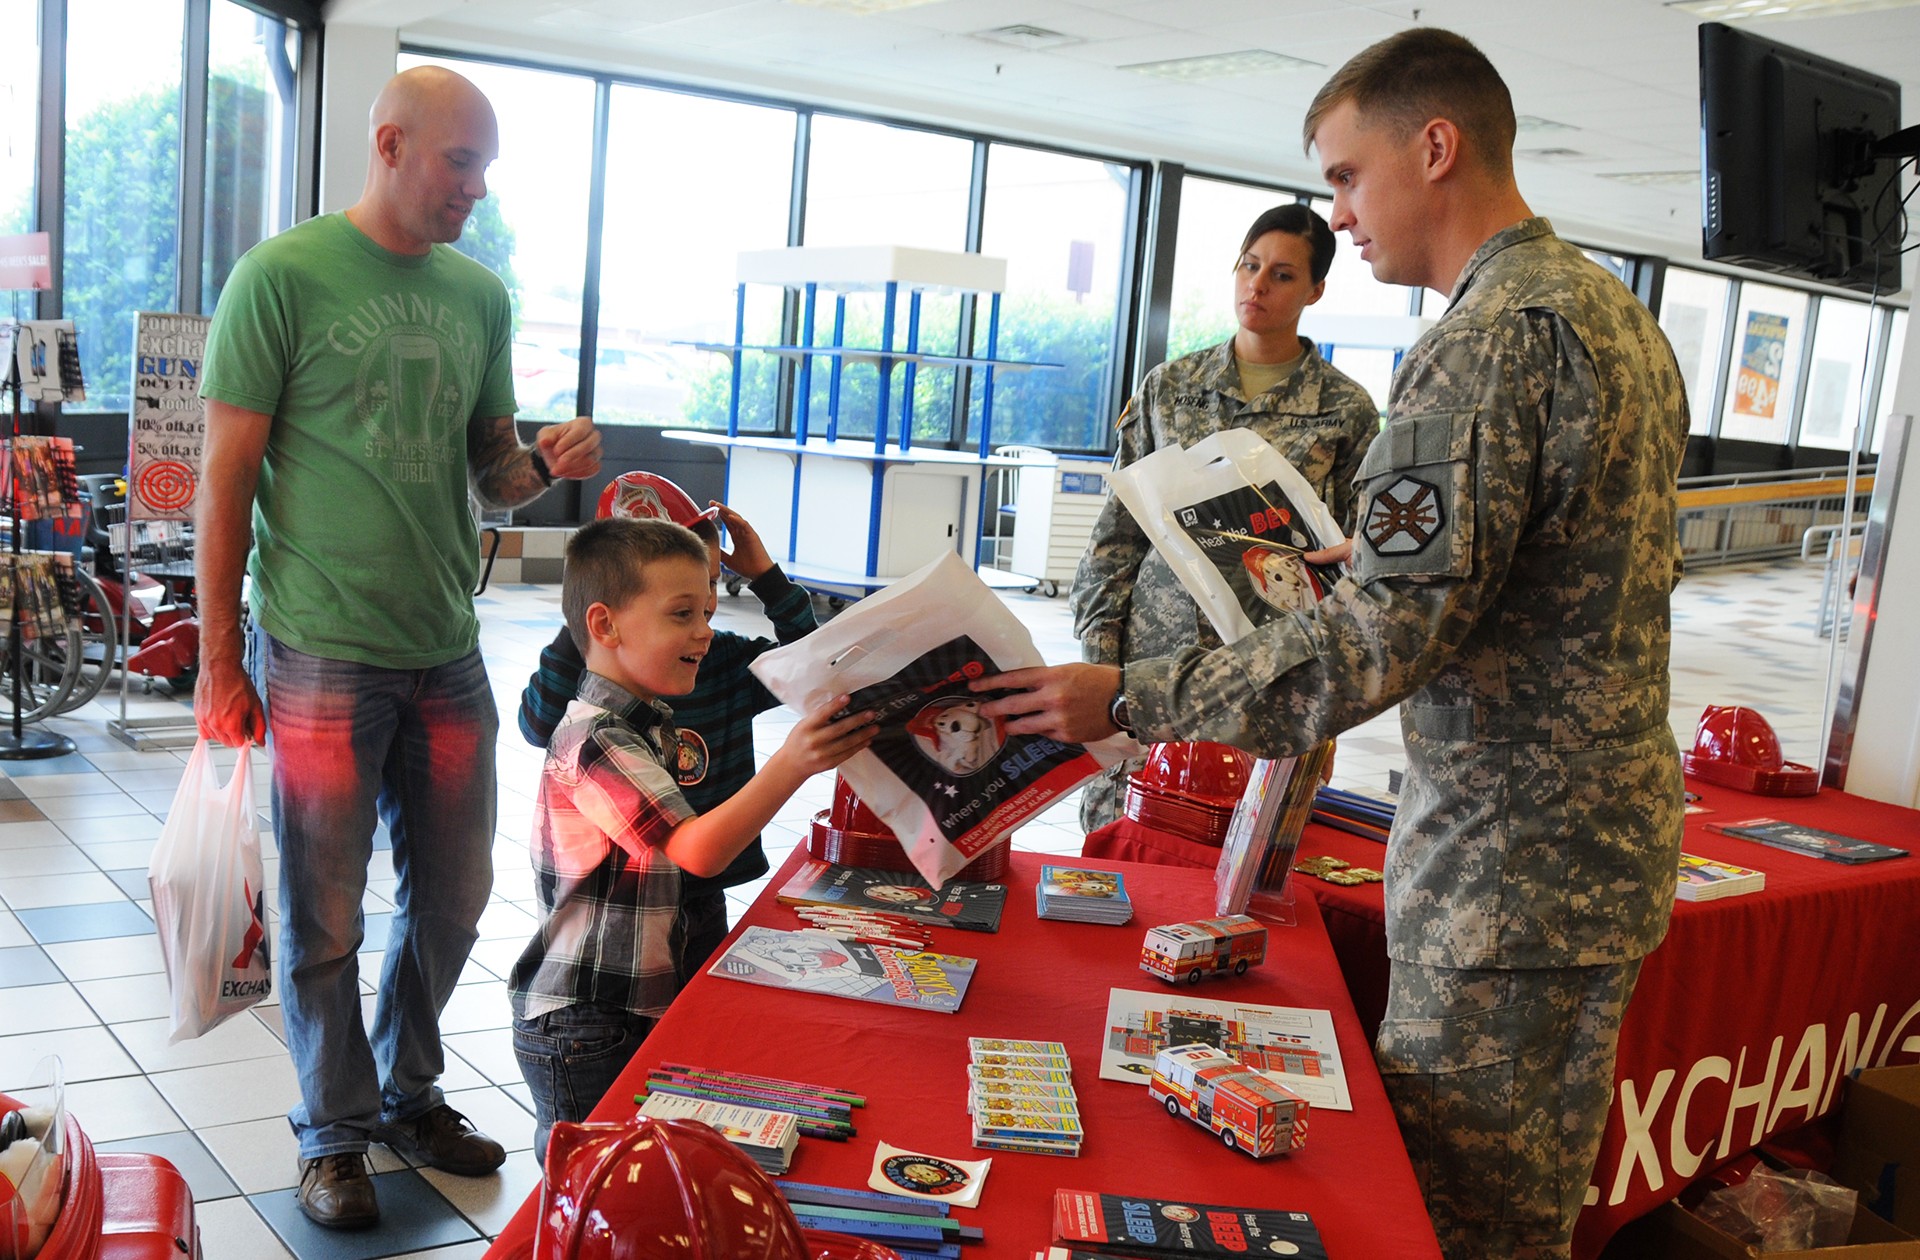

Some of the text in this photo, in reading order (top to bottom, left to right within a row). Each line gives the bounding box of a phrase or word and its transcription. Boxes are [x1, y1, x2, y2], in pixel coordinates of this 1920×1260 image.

[181, 318, 211, 335] Ru
[140, 333, 204, 357] Excha
[1313, 418, 1346, 429] ARMY
[1196, 531, 1225, 550] Hear
[1226, 525, 1249, 542] the
[889, 691, 919, 710] the
[942, 798, 983, 830] where
[980, 776, 1007, 801] you
[222, 980, 272, 998] EXCHAN
[1584, 1000, 1920, 1207] XCHAN
[1122, 1200, 1158, 1245] SLEEP
[1206, 1211, 1248, 1252] BEEP
